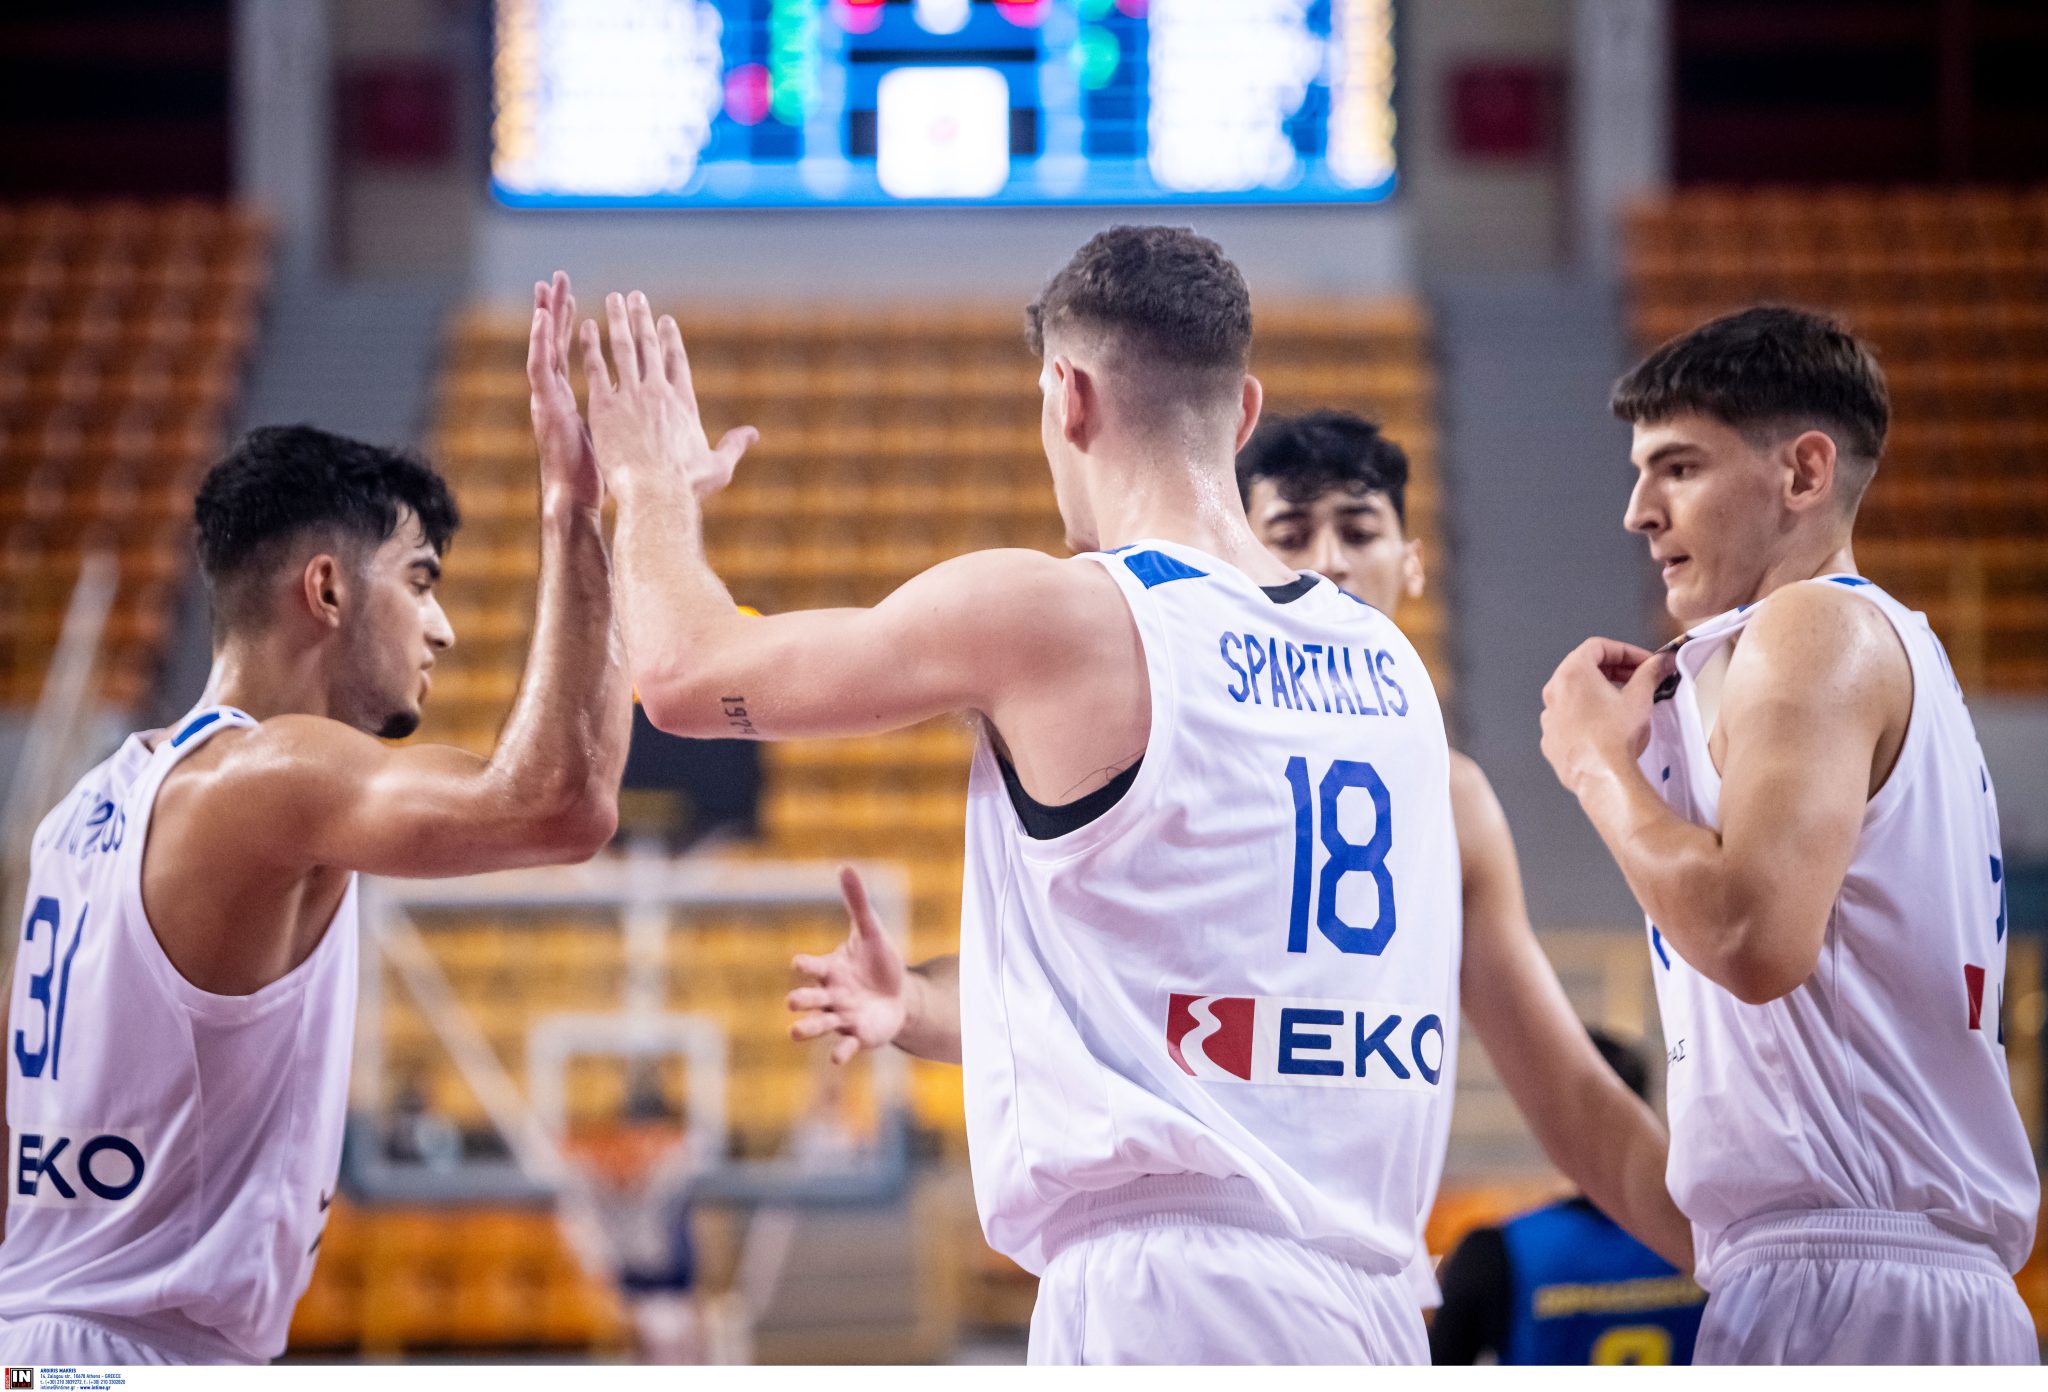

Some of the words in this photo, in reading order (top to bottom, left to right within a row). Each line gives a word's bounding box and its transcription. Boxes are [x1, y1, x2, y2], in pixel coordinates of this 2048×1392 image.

[1220, 630, 1409, 718] SPARTALIS
[1285, 755, 1397, 957] 18
[1277, 1007, 1444, 1086] EKO
[17, 1134, 145, 1202] EKO
